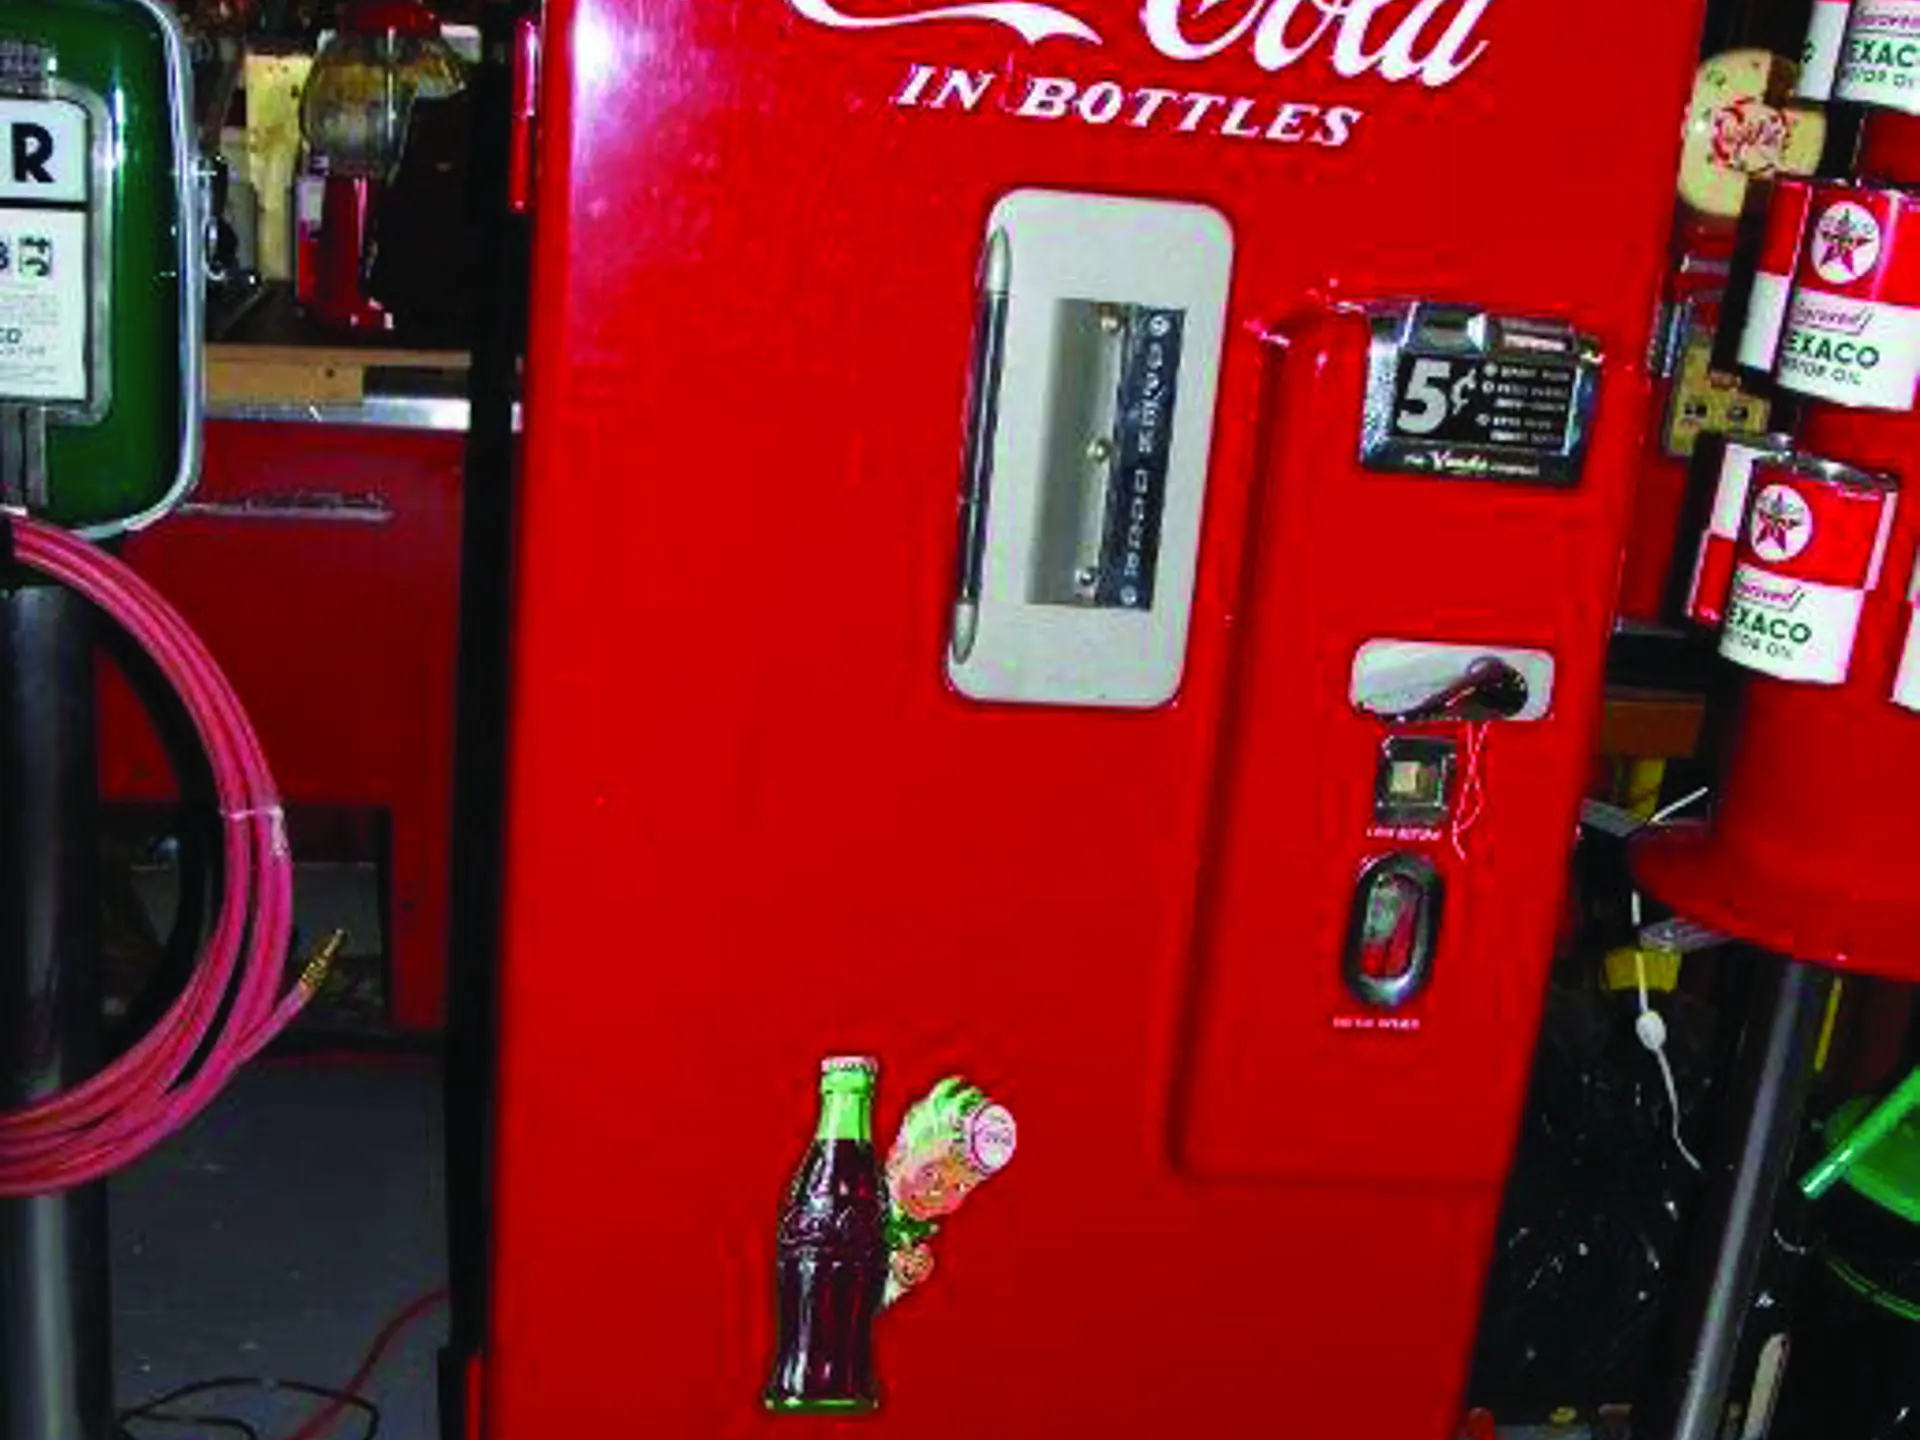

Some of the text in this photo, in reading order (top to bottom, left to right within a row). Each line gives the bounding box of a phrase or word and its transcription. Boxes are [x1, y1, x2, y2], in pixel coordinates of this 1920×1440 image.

[896, 62, 1363, 147] IN BOTTLES
[11, 122, 55, 183] R
